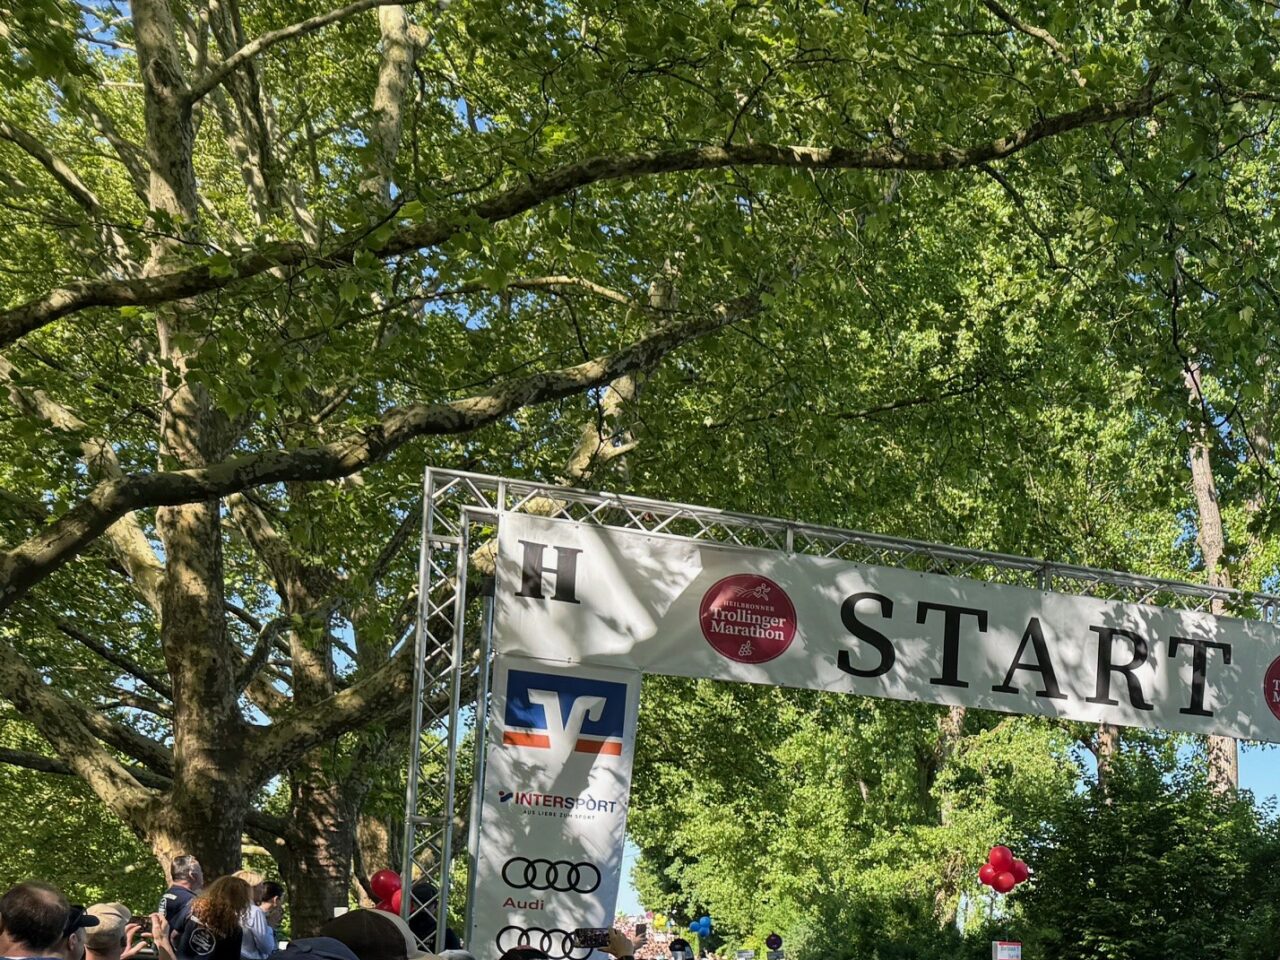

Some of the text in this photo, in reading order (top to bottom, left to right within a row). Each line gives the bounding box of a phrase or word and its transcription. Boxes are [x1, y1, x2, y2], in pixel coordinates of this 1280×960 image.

[515, 539, 583, 604] H
[723, 600, 775, 612] HEILBRONNER
[712, 608, 786, 628] Trollinger
[710, 620, 785, 641] Marathon
[837, 592, 1232, 717] START
[515, 792, 617, 813] INTERSPORT
[502, 897, 545, 910] Audi
